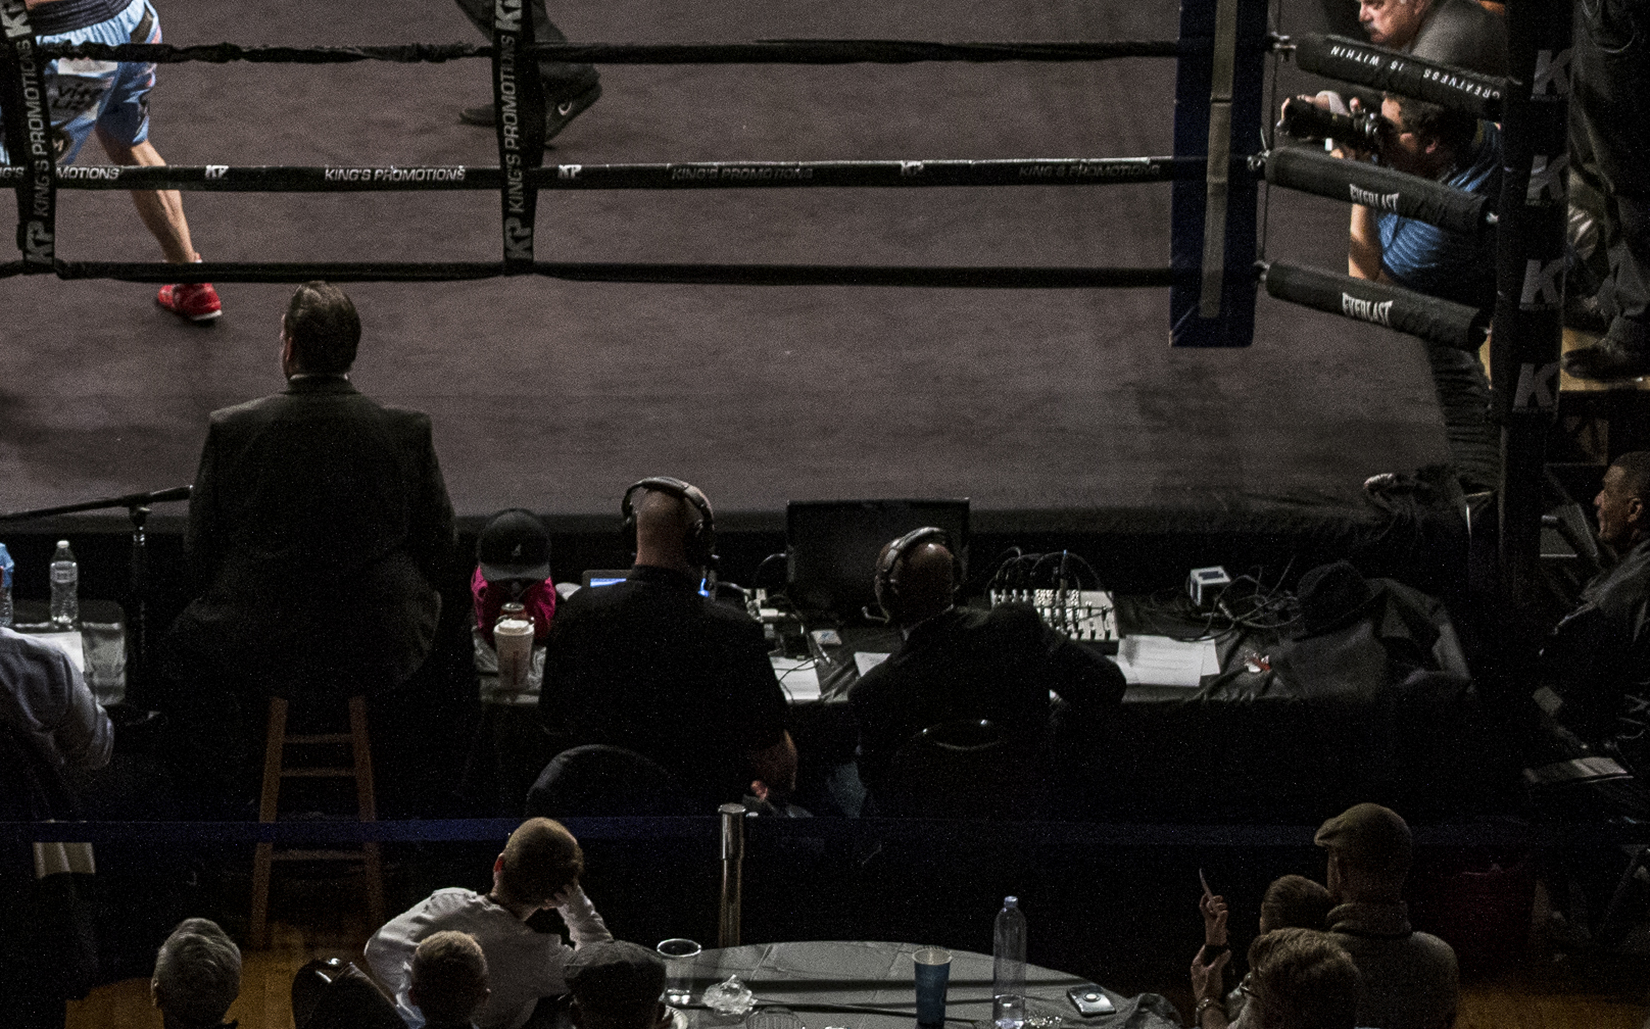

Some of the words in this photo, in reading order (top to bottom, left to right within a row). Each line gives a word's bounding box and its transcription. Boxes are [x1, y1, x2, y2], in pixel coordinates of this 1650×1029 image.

[1330, 44, 1380, 66] WITHIN
[1389, 59, 1405, 72] IS
[15, 38, 49, 157] PROMOTIONS
[499, 33, 521, 152] PROMOTIONS
[32, 156, 51, 218] KING'S
[55, 165, 120, 181] MOTIONS
[323, 168, 372, 182] KING'S
[373, 166, 466, 182] PROMOTIONS
[504, 152, 525, 216] KING'S
[720, 166, 814, 181] PROMOTIONS
[1348, 182, 1400, 212] EVERLAST
[25, 219, 54, 267] KP
[504, 215, 534, 262] KP
[1341, 291, 1394, 328] EVERLAST
